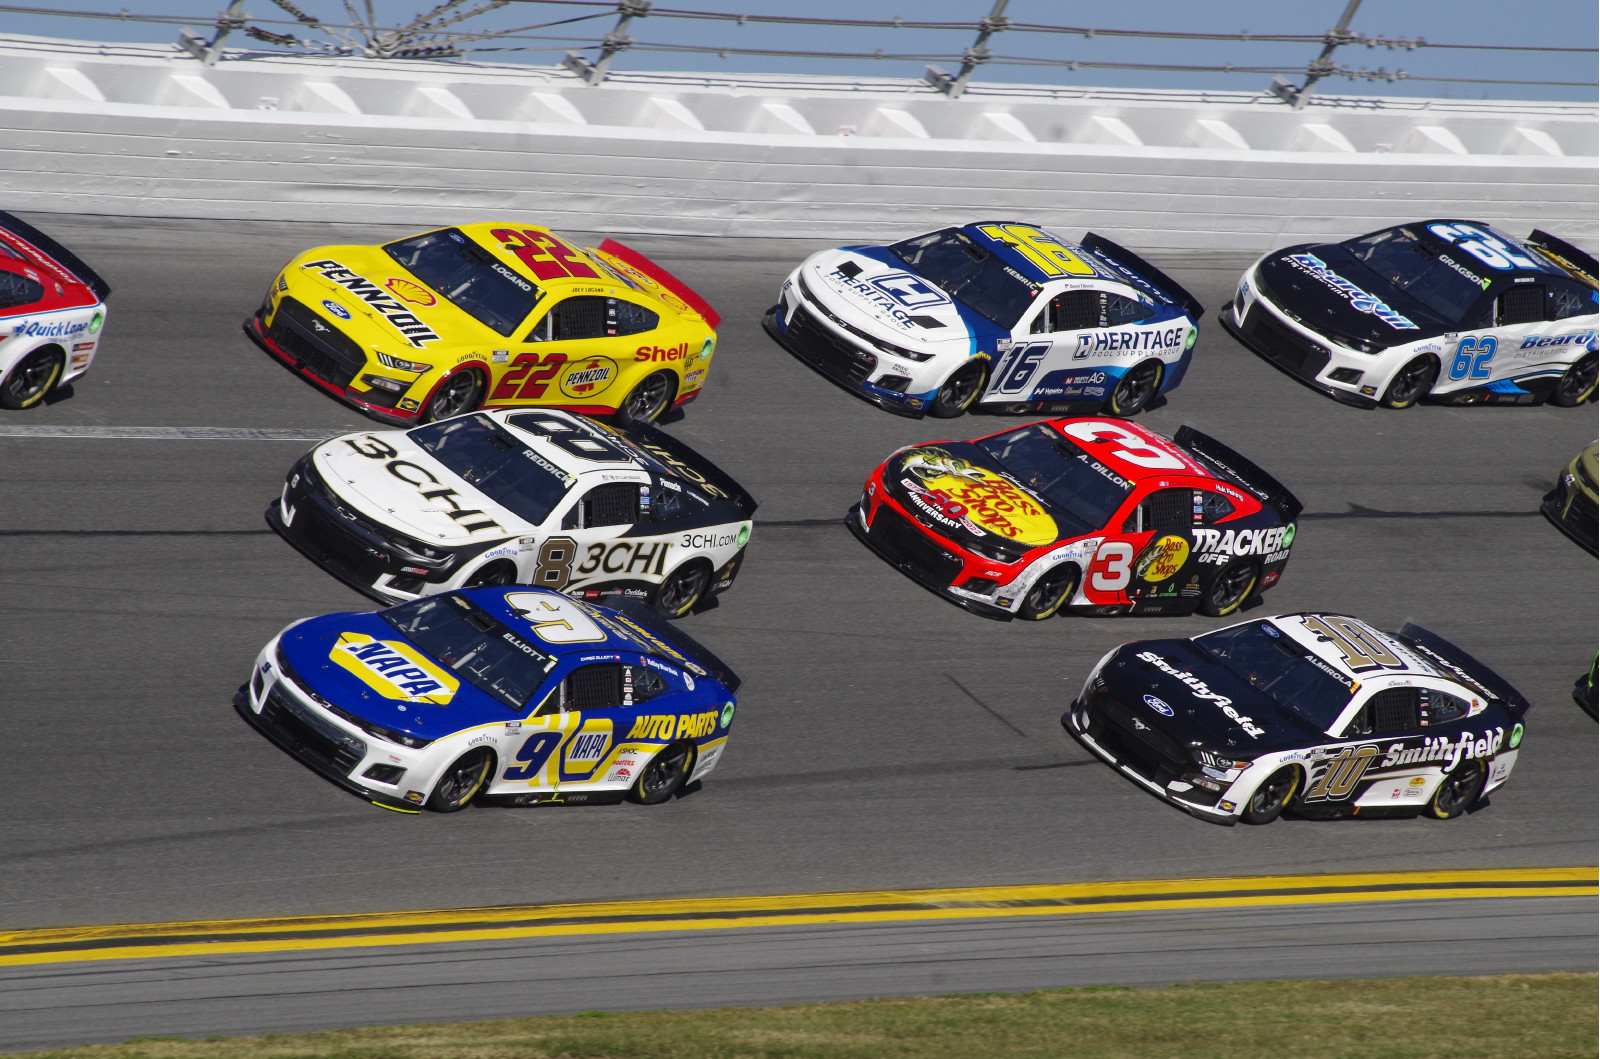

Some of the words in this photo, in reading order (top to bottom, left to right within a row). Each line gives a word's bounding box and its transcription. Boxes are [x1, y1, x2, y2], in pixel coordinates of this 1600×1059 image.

[491, 229, 602, 281] 22
[977, 224, 1097, 278] 16
[1427, 223, 1542, 271] 62
[491, 263, 532, 292] LOGANO
[1003, 266, 1036, 291] HEMRIC
[1438, 254, 1489, 288] GRAGSON
[301, 259, 443, 348] PENNZOIL
[323, 301, 350, 318] Ford
[830, 270, 915, 329] HERITAGE
[633, 342, 689, 363] Shell
[1095, 328, 1183, 351] HERITAGE
[1158, 348, 1180, 356] GROUP
[1514, 348, 1568, 359] DISTRIBUTING
[1519, 329, 1595, 350] Beard
[990, 341, 1053, 394] 16
[1449, 335, 1499, 381] 62
[489, 353, 568, 399] 22
[565, 367, 611, 387] PENNZOIL
[505, 412, 632, 463] 8
[1063, 421, 1186, 470] 3
[291, 474, 299, 488] 8
[522, 449, 576, 484] REDDICK
[1077, 454, 1088, 464] A.
[1090, 462, 1130, 490] DILLON
[341, 435, 503, 535] 3CHI
[868, 482, 876, 496] 3
[908, 491, 962, 529] ANNIVERSARY
[921, 489, 968, 519] 50
[933, 503, 943, 511] TH
[946, 488, 1023, 537] Shops
[681, 534, 737, 548] 3CHI.COM
[962, 519, 982, 535] 2022
[1191, 526, 1286, 556] TRACKER
[485, 547, 518, 559] GOODYEAR
[576, 541, 671, 577] 3CHI
[1157, 550, 1174, 563] Pro
[1162, 538, 1183, 552] Bass
[1198, 553, 1229, 565] OFF
[1264, 550, 1288, 564] ROAD
[532, 536, 578, 591] 8
[1092, 542, 1134, 592] 3
[1152, 561, 1178, 577] Shops
[504, 592, 607, 644] 9
[502, 632, 545, 662] ELLIOTT
[1300, 615, 1408, 673] 10
[348, 642, 442, 697] NAPA
[1304, 654, 1352, 687] ALMIROLA
[1136, 651, 1266, 739] Smithfield
[1146, 696, 1171, 715] Ford
[468, 734, 498, 746] GOODYEAR
[626, 715, 677, 740] AUTO
[676, 711, 719, 739] PARTS
[503, 731, 563, 782] 9
[570, 734, 607, 759] NAPA
[1279, 752, 1306, 763] GOODYEAR
[1381, 727, 1504, 772] Smithfield
[1306, 745, 1379, 802] 10
